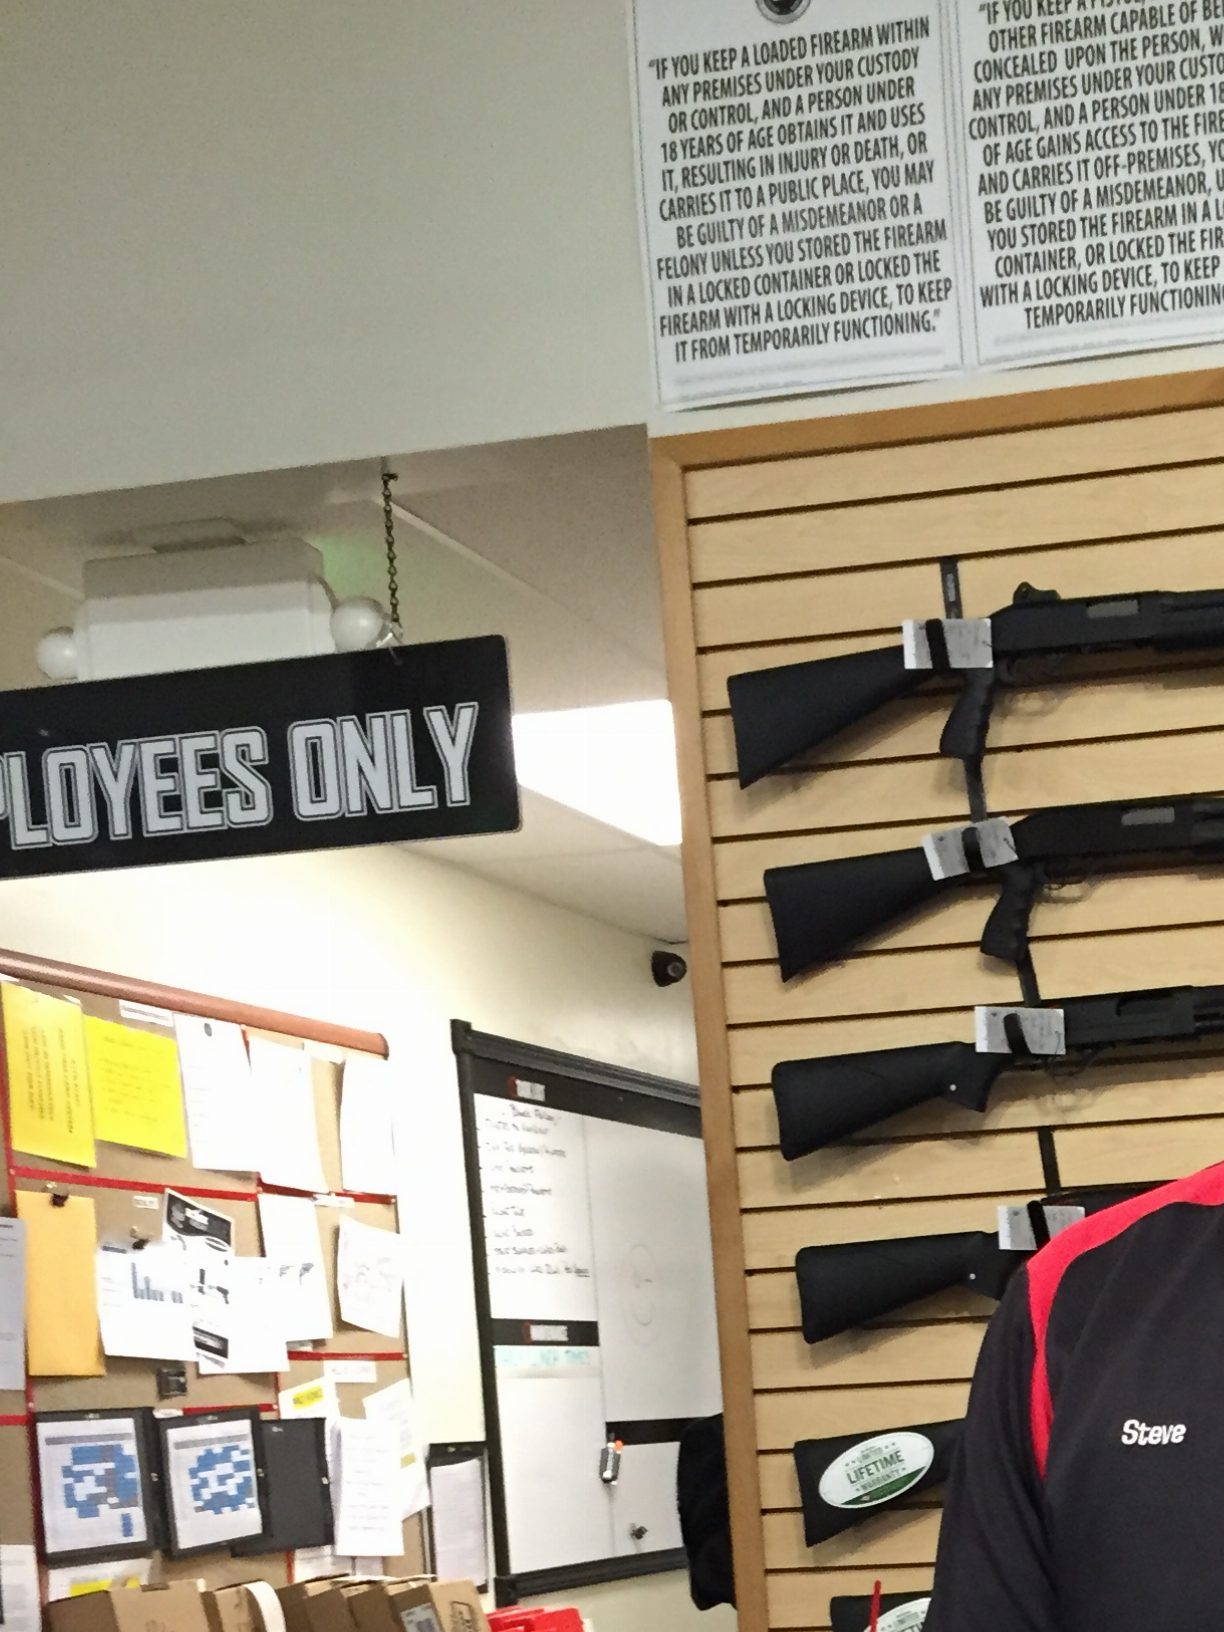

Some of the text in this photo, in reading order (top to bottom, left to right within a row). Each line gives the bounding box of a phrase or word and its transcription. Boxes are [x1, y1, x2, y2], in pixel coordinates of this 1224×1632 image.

[671, 53, 699, 78] YOU
[703, 47, 737, 73] KEEP
[741, 45, 751, 68] A
[753, 36, 807, 66] LOADED
[810, 27, 874, 56] FIREARM
[876, 16, 930, 45] WITHIN
[974, 50, 1057, 83] CONCEALED
[1064, 43, 1106, 70] UPON
[1109, 37, 1138, 63] THE
[1142, 29, 1205, 58] PERSON,
[662, 47, 920, 107] ANY PREMISES UNDER YOUR CUSTODY
[973, 86, 1001, 112] ANY
[1005, 75, 1078, 106] PREMISES
[1081, 67, 1133, 95] UNDER
[1135, 60, 1176, 87] YOUR
[978, 172, 1009, 199] AND
[1012, 161, 1073, 191] CARRIES
[1076, 157, 1090, 182] IT
[1094, 143, 1206, 179] OFF-PREMISES,
[657, 218, 947, 280] FELONY UNLESS YOU STORED THE FIREARM
[660, 277, 952, 336] FIREARM WITH A LOCKING DEVICE, TO KEEP
[1025, 297, 1126, 330] TEMPORARILY
[675, 340, 688, 363] IT
[691, 335, 731, 360] FROM
[733, 323, 830, 354] TEMPORARILY
[0, 702, 479, 851] LOYEES ONLY
[1121, 1418, 1187, 1445] Steve
[846, 1450, 905, 1484] LIFETIME
